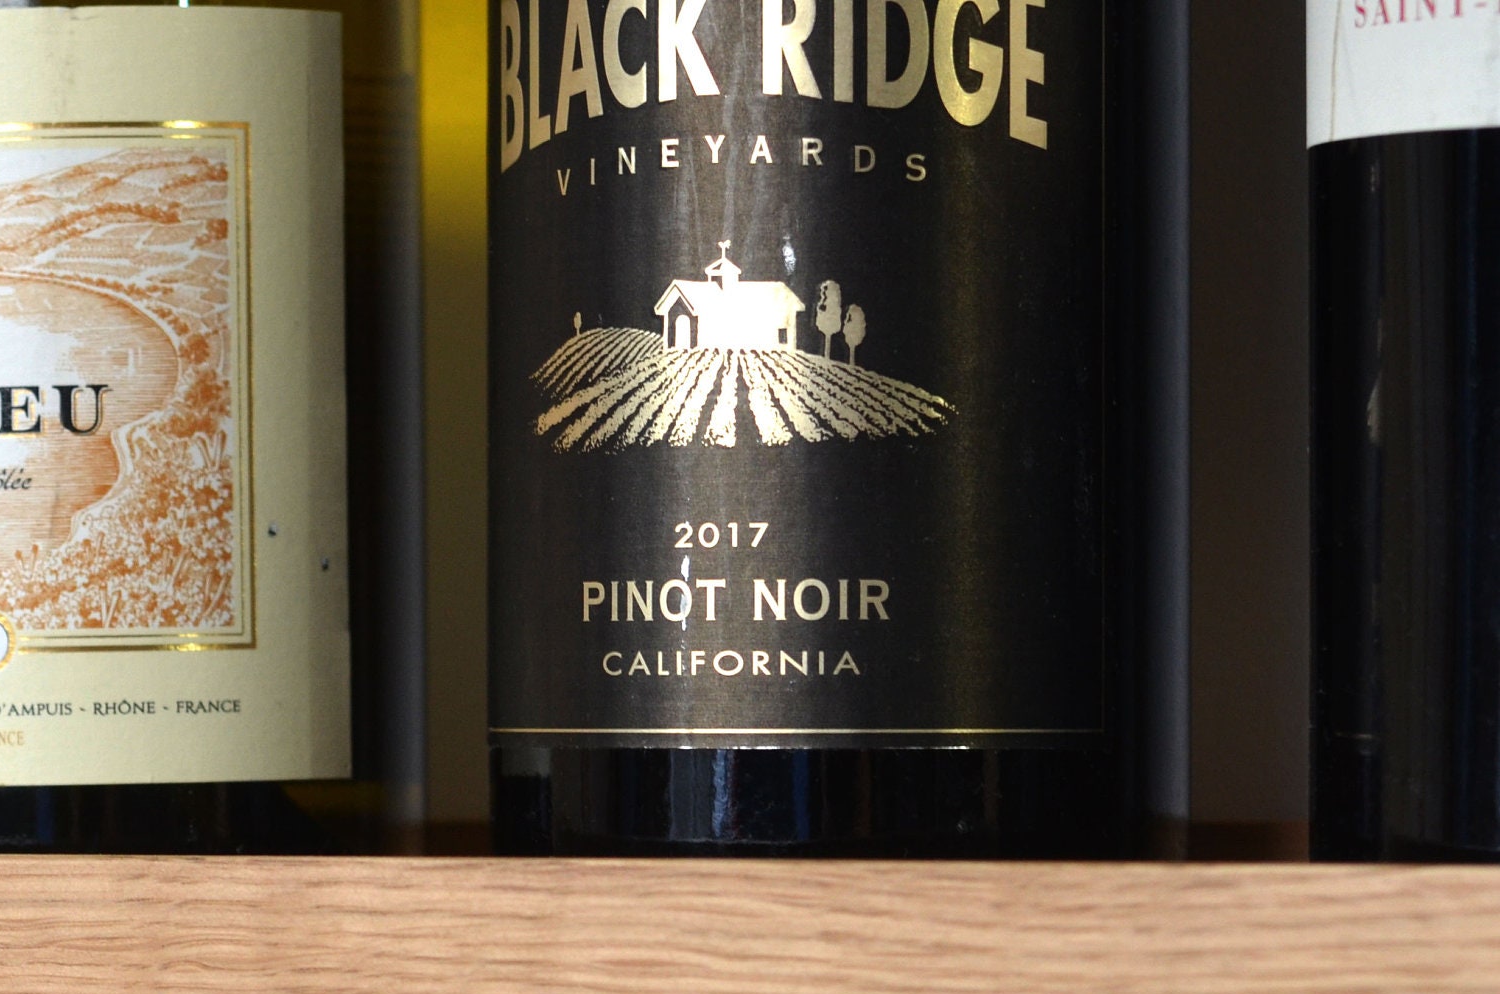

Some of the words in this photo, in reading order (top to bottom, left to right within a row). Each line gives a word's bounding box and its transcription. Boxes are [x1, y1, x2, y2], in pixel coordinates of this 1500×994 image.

[501, 0, 720, 173] BLACK
[762, 0, 1047, 149] RIDGE
[557, 134, 927, 196] VINEYARDS
[673, 521, 769, 549] 2017
[582, 579, 726, 622] PINOT
[753, 578, 890, 621] NOIR
[602, 650, 861, 677] CALIFORNIA
[93, 699, 156, 716] RHÔNE
[175, 699, 241, 715] FRANCE
